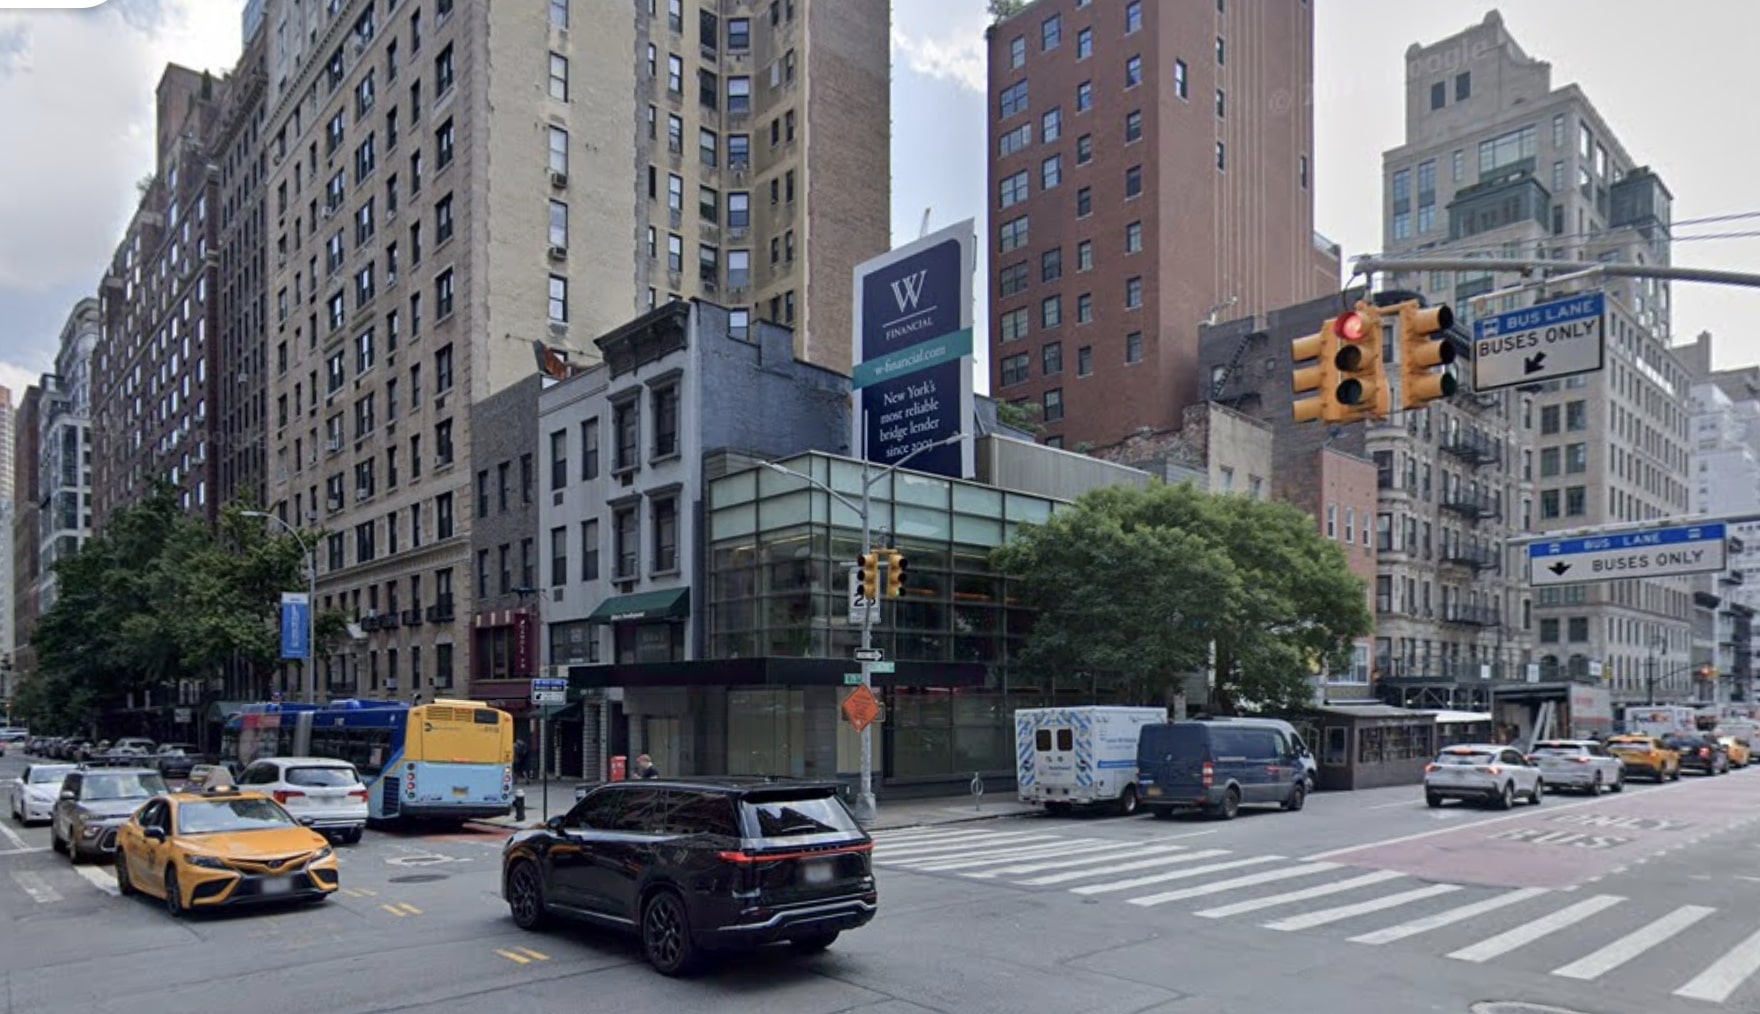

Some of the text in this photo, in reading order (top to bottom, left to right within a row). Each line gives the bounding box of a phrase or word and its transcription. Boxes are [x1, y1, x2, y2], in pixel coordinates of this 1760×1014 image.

[891, 269, 927, 312] W
[1506, 300, 1595, 329] BUS LANE
[886, 317, 933, 340] FINANCIAL
[1479, 320, 1596, 357] BUSES ONLY
[875, 346, 946, 375] w-financial.com
[883, 380, 937, 407] New York's
[881, 397, 939, 424] most reliable
[880, 416, 940, 441] bridge lender
[886, 444, 909, 457] since
[1583, 532, 1660, 550] BUS LANE
[1592, 549, 1704, 572] BUSES ONLY
